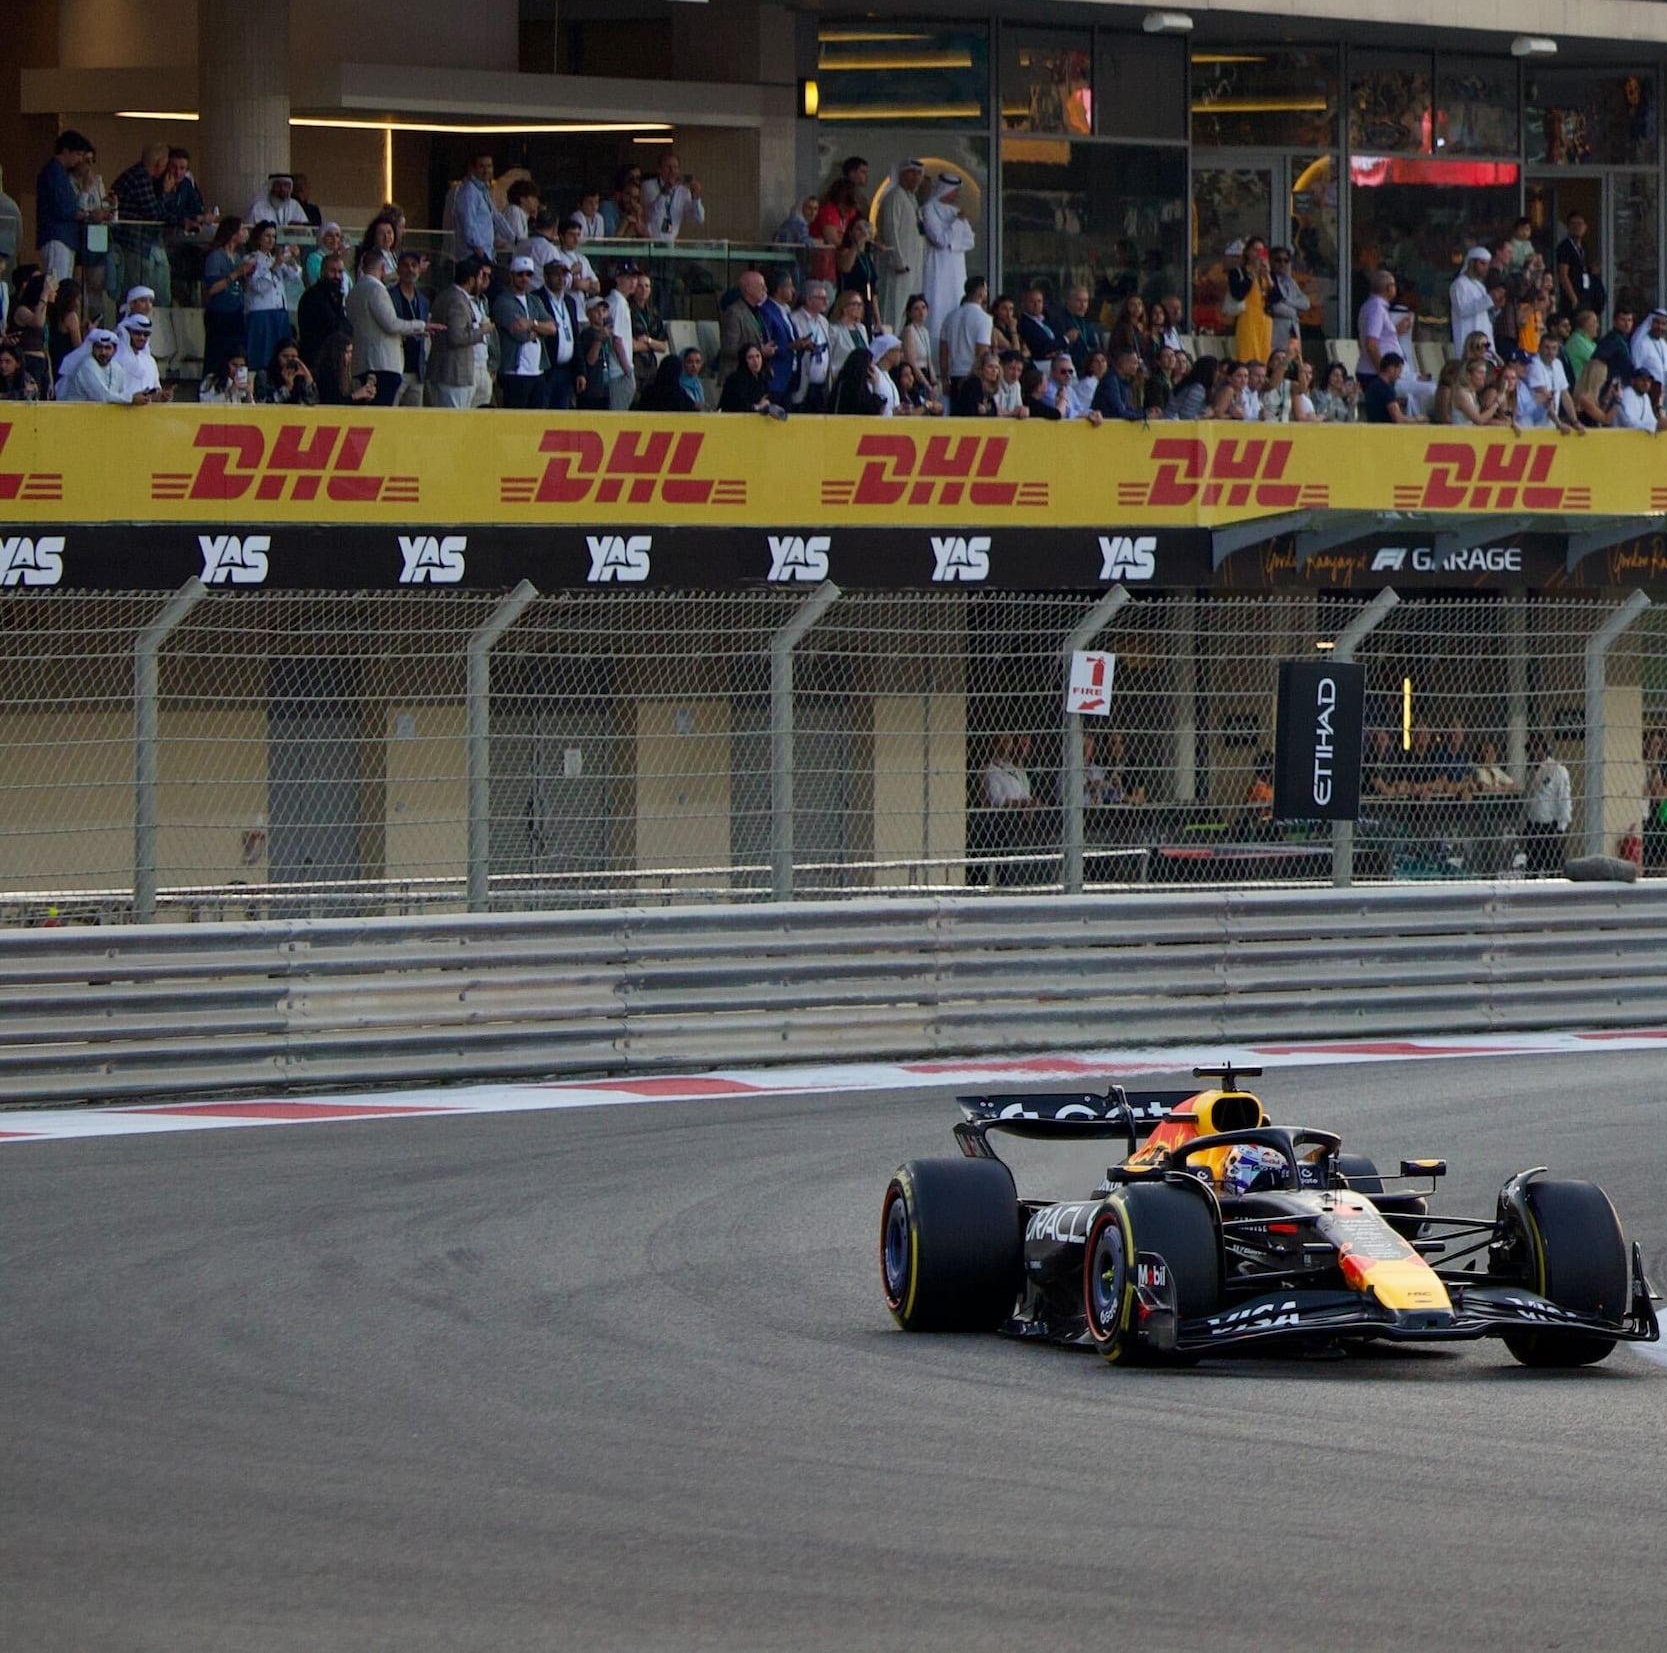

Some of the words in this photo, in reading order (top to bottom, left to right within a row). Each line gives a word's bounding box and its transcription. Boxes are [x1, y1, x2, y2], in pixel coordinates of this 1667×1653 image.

[189, 423, 384, 502] DHL
[535, 428, 714, 504] DHL
[852, 434, 1018, 506] DHL
[1147, 438, 1301, 508] DHL
[1419, 442, 1564, 509] DHL
[198, 535, 271, 584] YAS
[398, 536, 467, 583] YAS
[586, 535, 652, 582] YAS
[767, 536, 831, 581] YAS
[930, 536, 992, 581] YAS
[1098, 536, 1157, 580] YAS
[1073, 686, 1103, 696] FIRE
[1313, 677, 1337, 806] ETIHAD
[1138, 1263, 1166, 1288] Mobil
[1207, 1300, 1300, 1335] VISA
